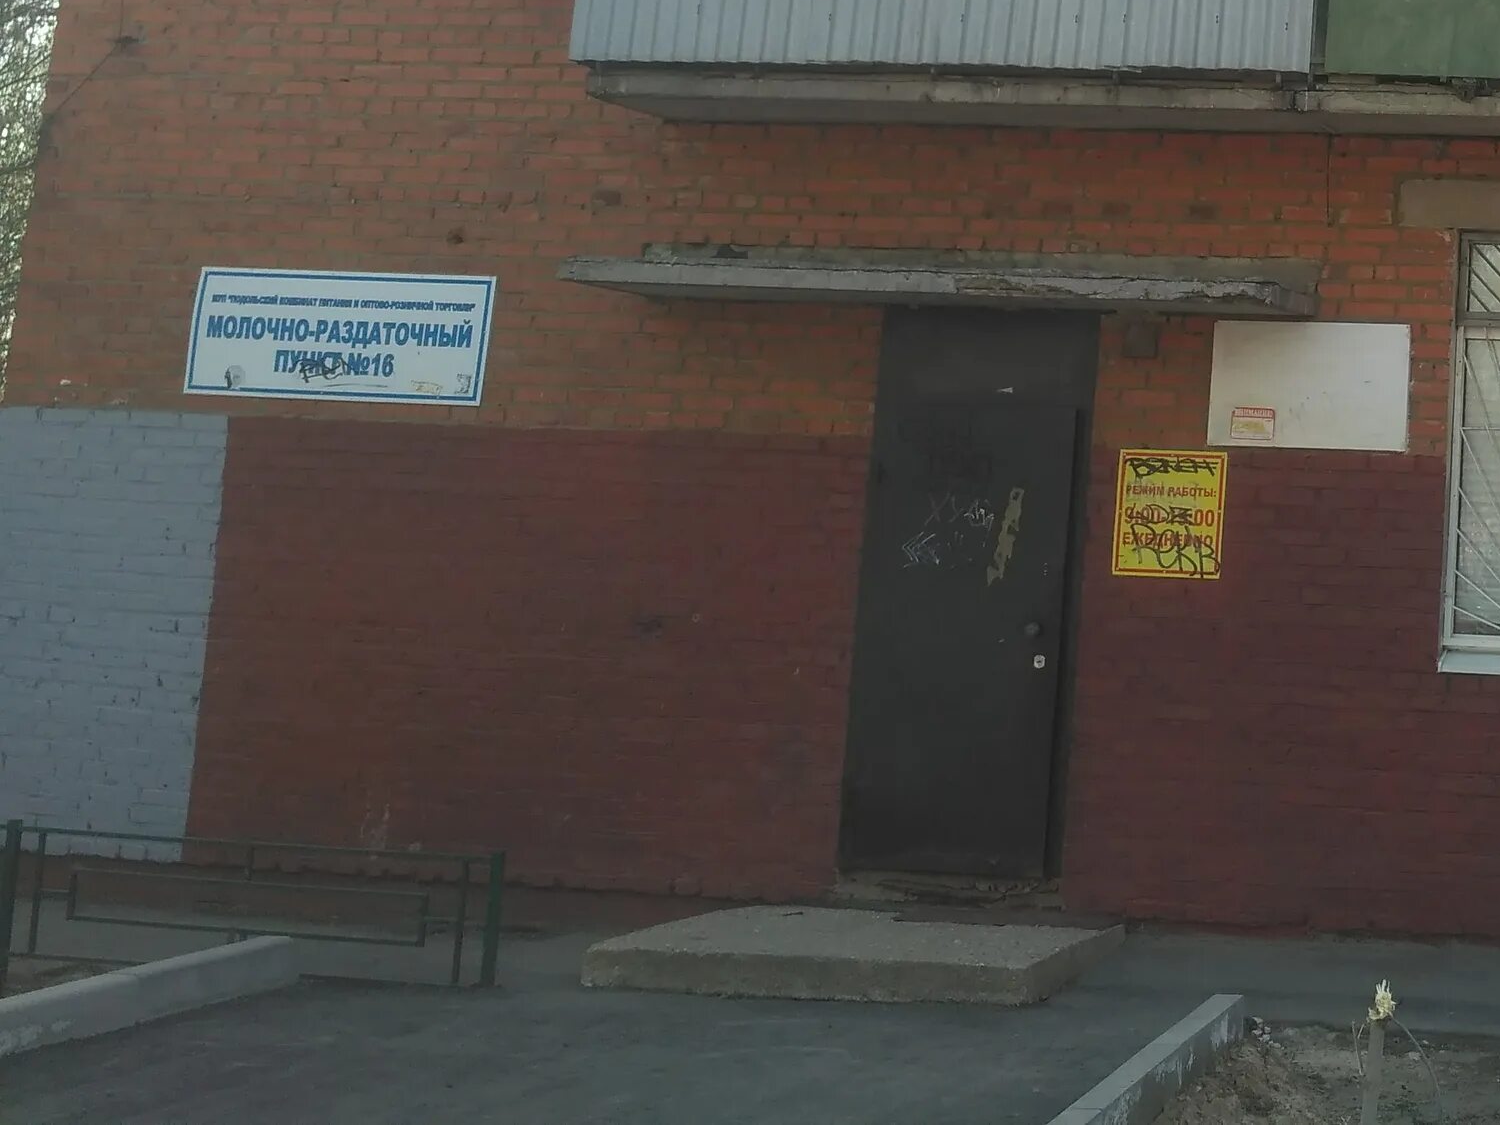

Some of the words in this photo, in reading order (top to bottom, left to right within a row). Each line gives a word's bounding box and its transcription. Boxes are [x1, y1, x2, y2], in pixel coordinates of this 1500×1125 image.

[206, 315, 473, 348] МОЛОЧНО-РАЗДАТОЧНЫЙ
[347, 352, 395, 377] №16
[1126, 484, 1165, 497] РЕЖИМ
[1167, 485, 1217, 498] РАБОТЫ:
